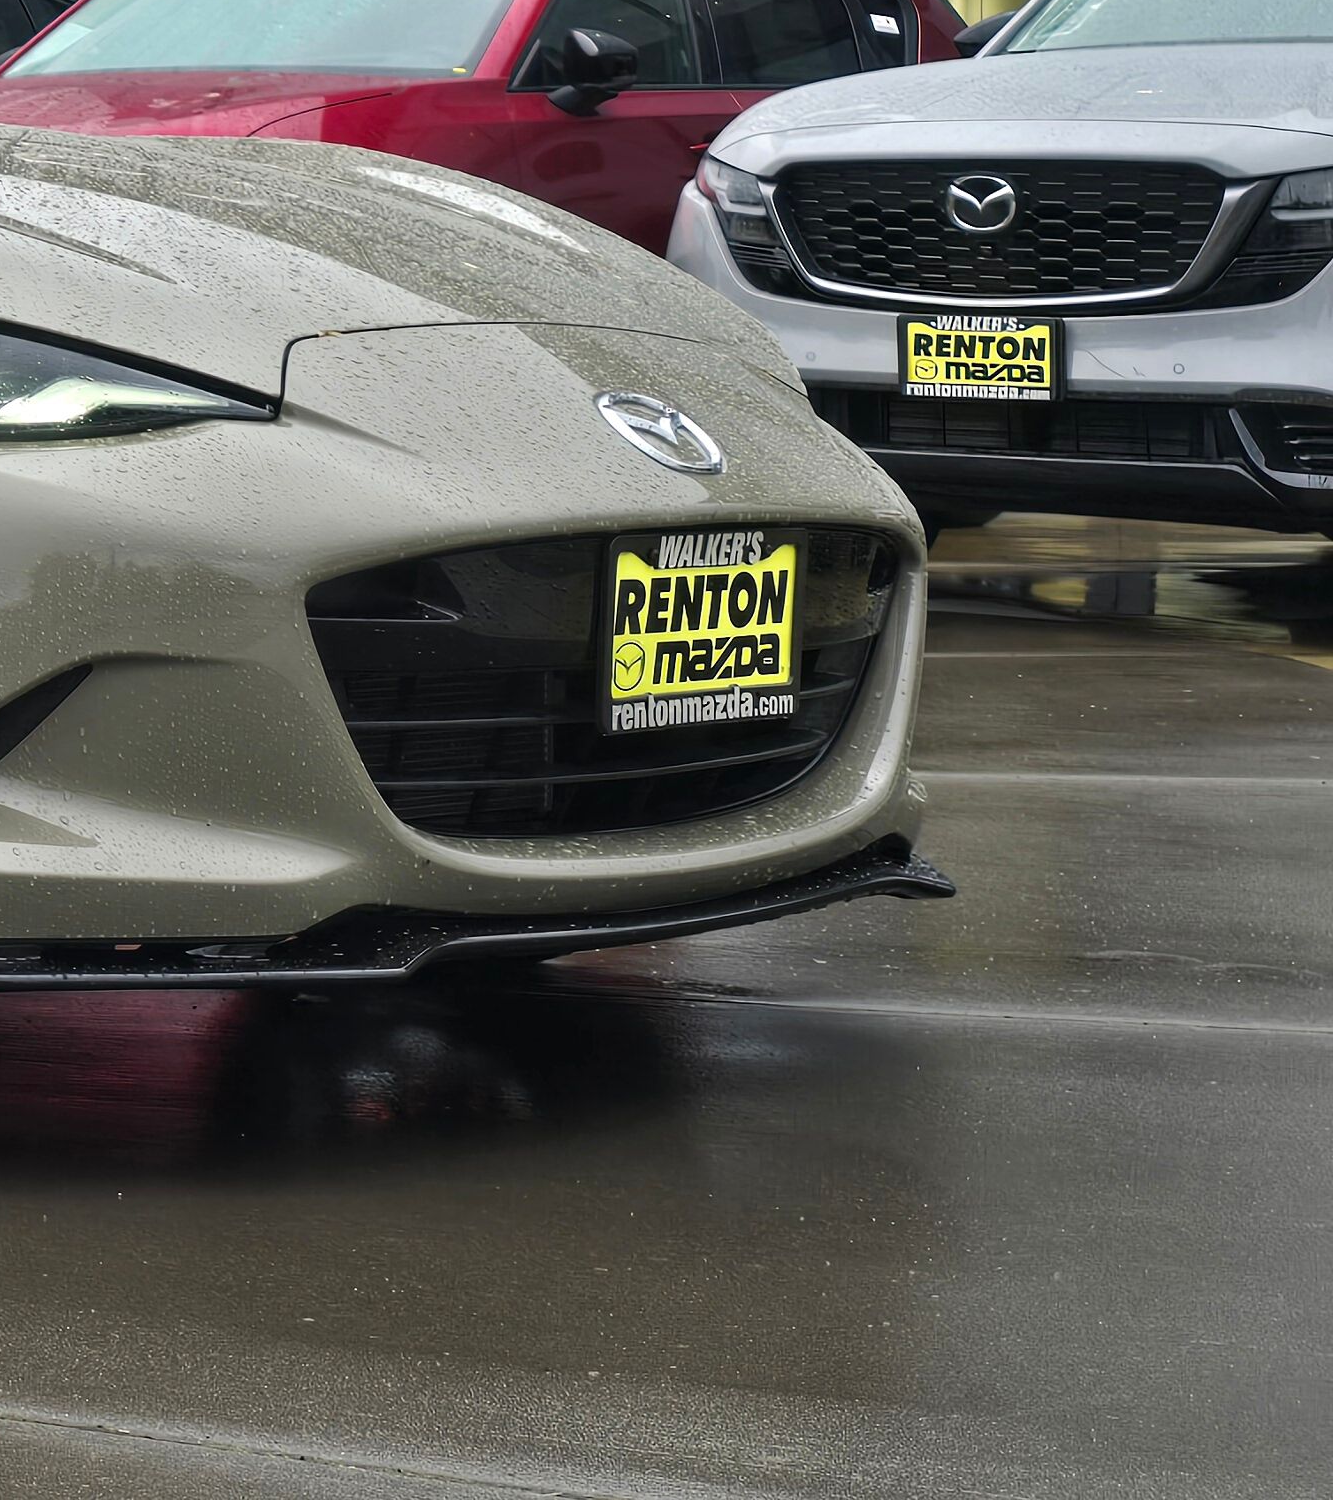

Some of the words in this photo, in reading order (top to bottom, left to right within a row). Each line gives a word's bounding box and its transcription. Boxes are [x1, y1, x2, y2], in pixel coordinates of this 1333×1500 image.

[913, 333, 1046, 361] RENTON
[657, 531, 764, 569] WALKER'S
[614, 570, 788, 636] RENTON
[611, 685, 794, 731] rentonmazda.com
